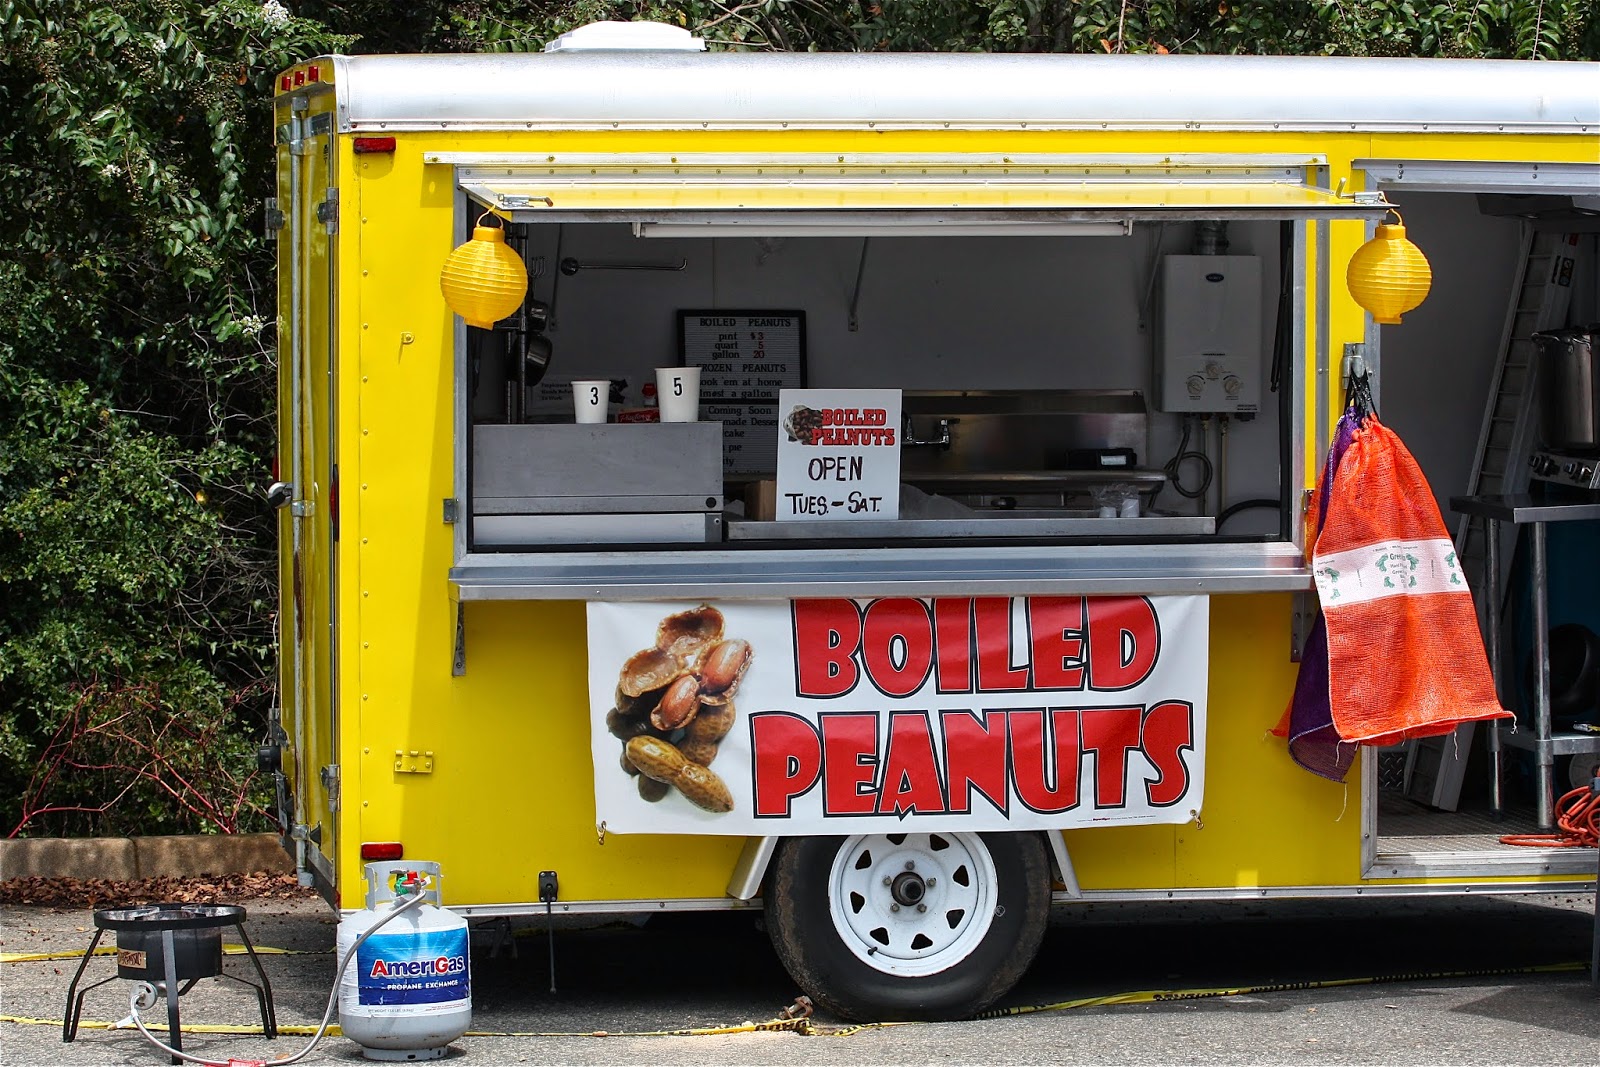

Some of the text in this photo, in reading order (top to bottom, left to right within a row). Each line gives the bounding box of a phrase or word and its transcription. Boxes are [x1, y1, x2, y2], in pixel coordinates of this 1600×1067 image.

[699, 318, 791, 327] BOILED PEANUTS
[719, 332, 738, 342] pint
[714, 341, 764, 350] quart 5
[712, 350, 765, 360] gallon 20
[743, 364, 787, 373] PEANUTS
[700, 377, 718, 386] ook
[742, 378, 751, 386] at
[757, 377, 783, 386] home
[673, 377, 683, 397] 5
[590, 387, 599, 405] 3
[700, 389, 724, 398] lmost
[741, 389, 772, 399] gallon
[708, 406, 772, 415] Coming Soon
[821, 408, 887, 426] BOILED
[724, 429, 745, 437] cake
[811, 428, 895, 446] PEANUTS
[729, 444, 742, 453] pie
[808, 456, 863, 481] OPEN
[790, 596, 1161, 699] BOILED
[748, 699, 1194, 820] PEANUTS
[370, 956, 466, 978] AmeriGas
[387, 979, 459, 991] PROPANE EXCHANGE
